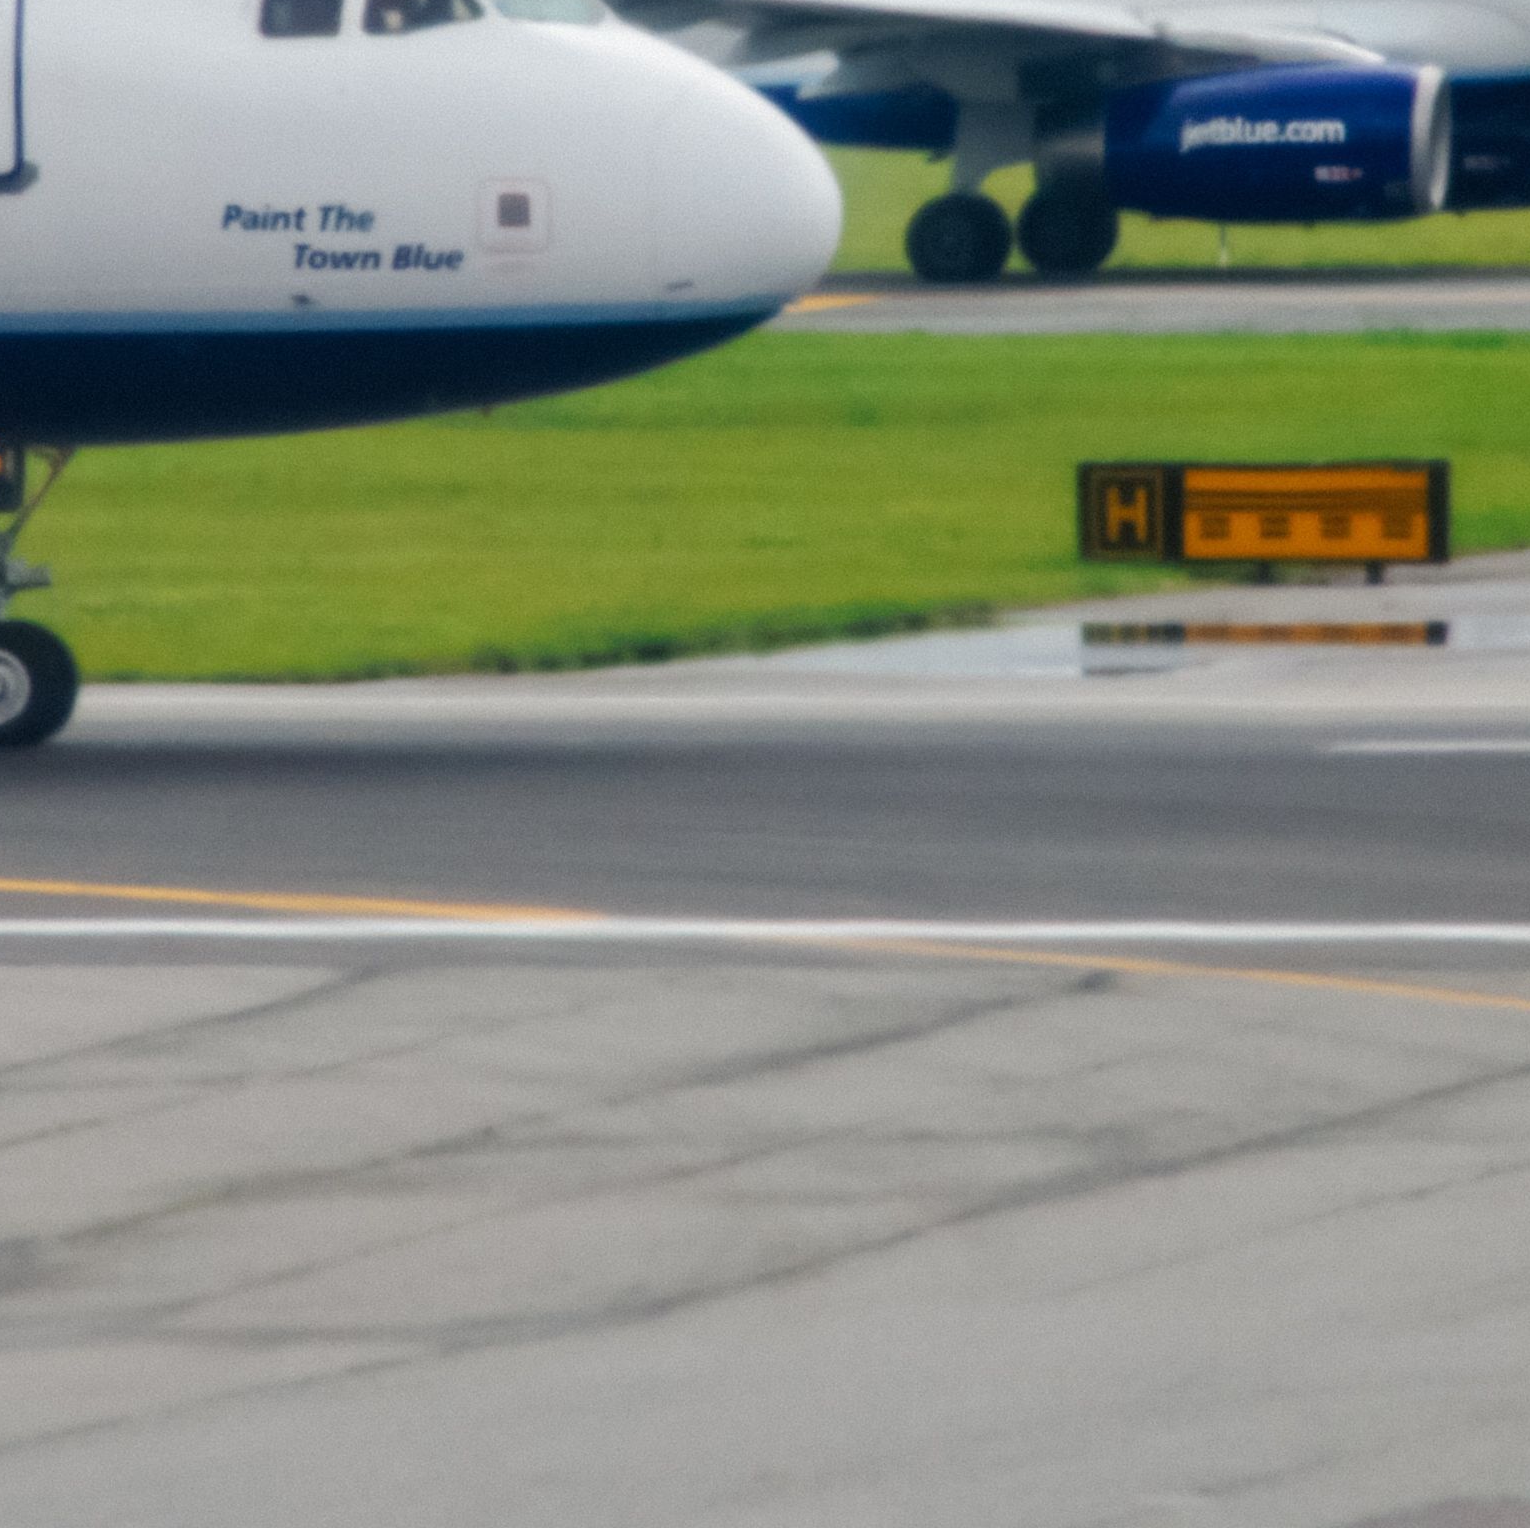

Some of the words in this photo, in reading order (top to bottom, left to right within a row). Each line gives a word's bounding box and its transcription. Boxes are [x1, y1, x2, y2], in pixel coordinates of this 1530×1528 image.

[1179, 116, 1345, 154] jetblue.com
[222, 203, 306, 231] Paint
[318, 203, 375, 231] The
[294, 242, 380, 271] Town
[392, 241, 464, 271] Blue
[1105, 486, 1148, 542] H
